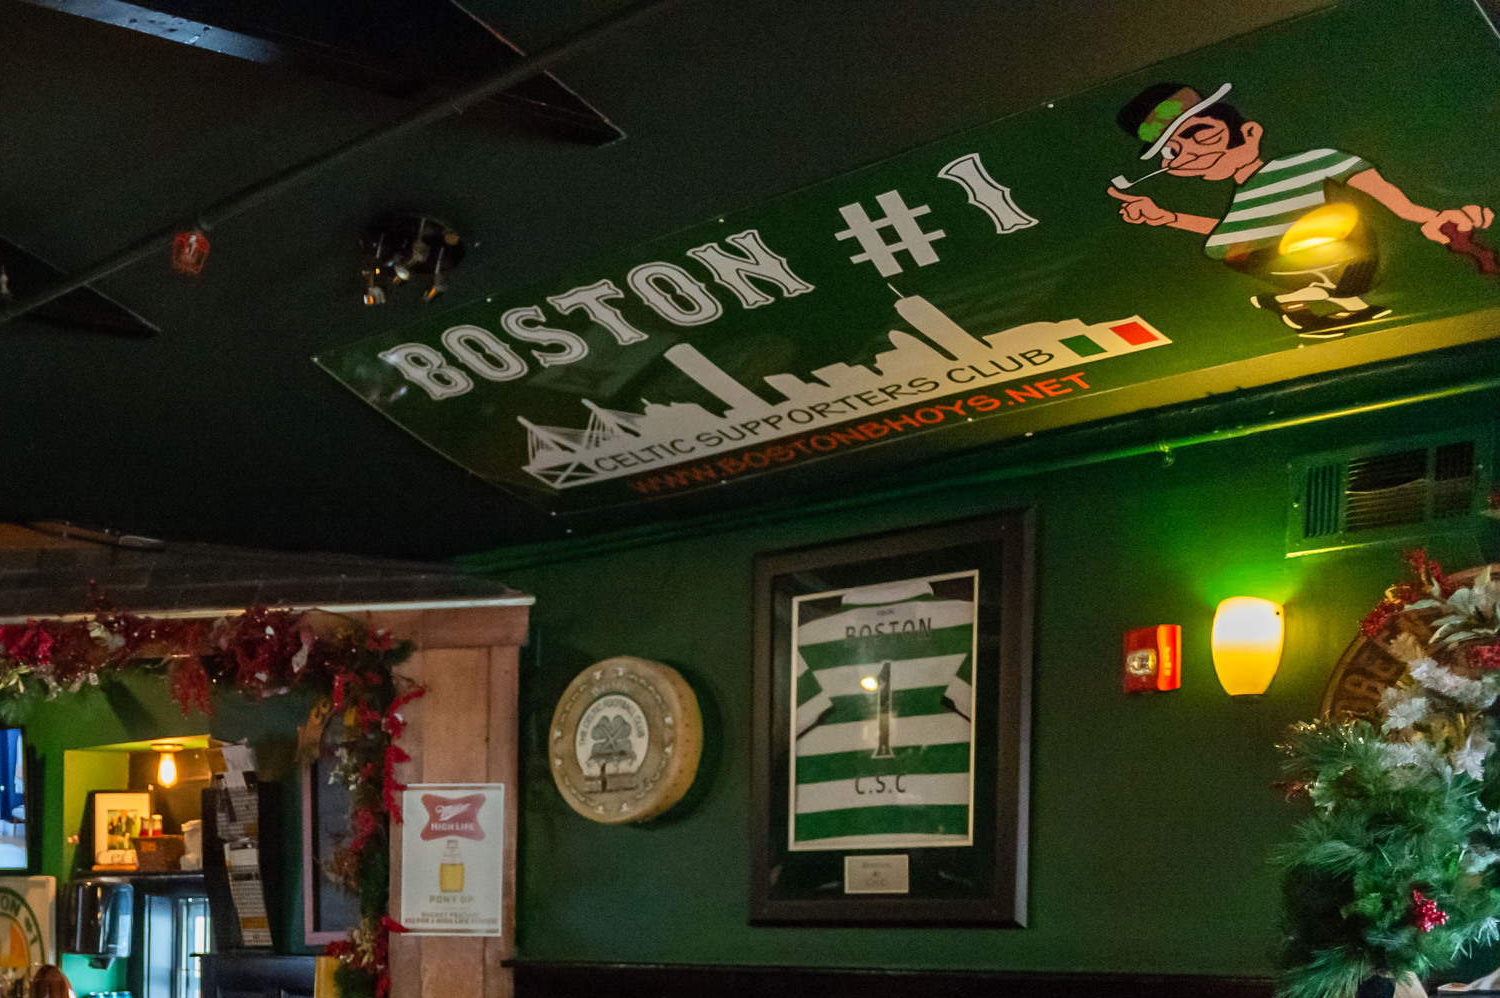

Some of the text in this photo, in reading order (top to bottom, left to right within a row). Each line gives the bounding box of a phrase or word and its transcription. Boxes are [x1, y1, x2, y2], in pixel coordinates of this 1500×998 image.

[378, 152, 1040, 400] BOSTON #1
[594, 349, 1055, 472] CELTIC SUPPORTERS CLUB
[845, 617, 932, 643] BOSTON
[871, 660, 895, 758] 1
[431, 823, 474, 831] HIGH LIFE
